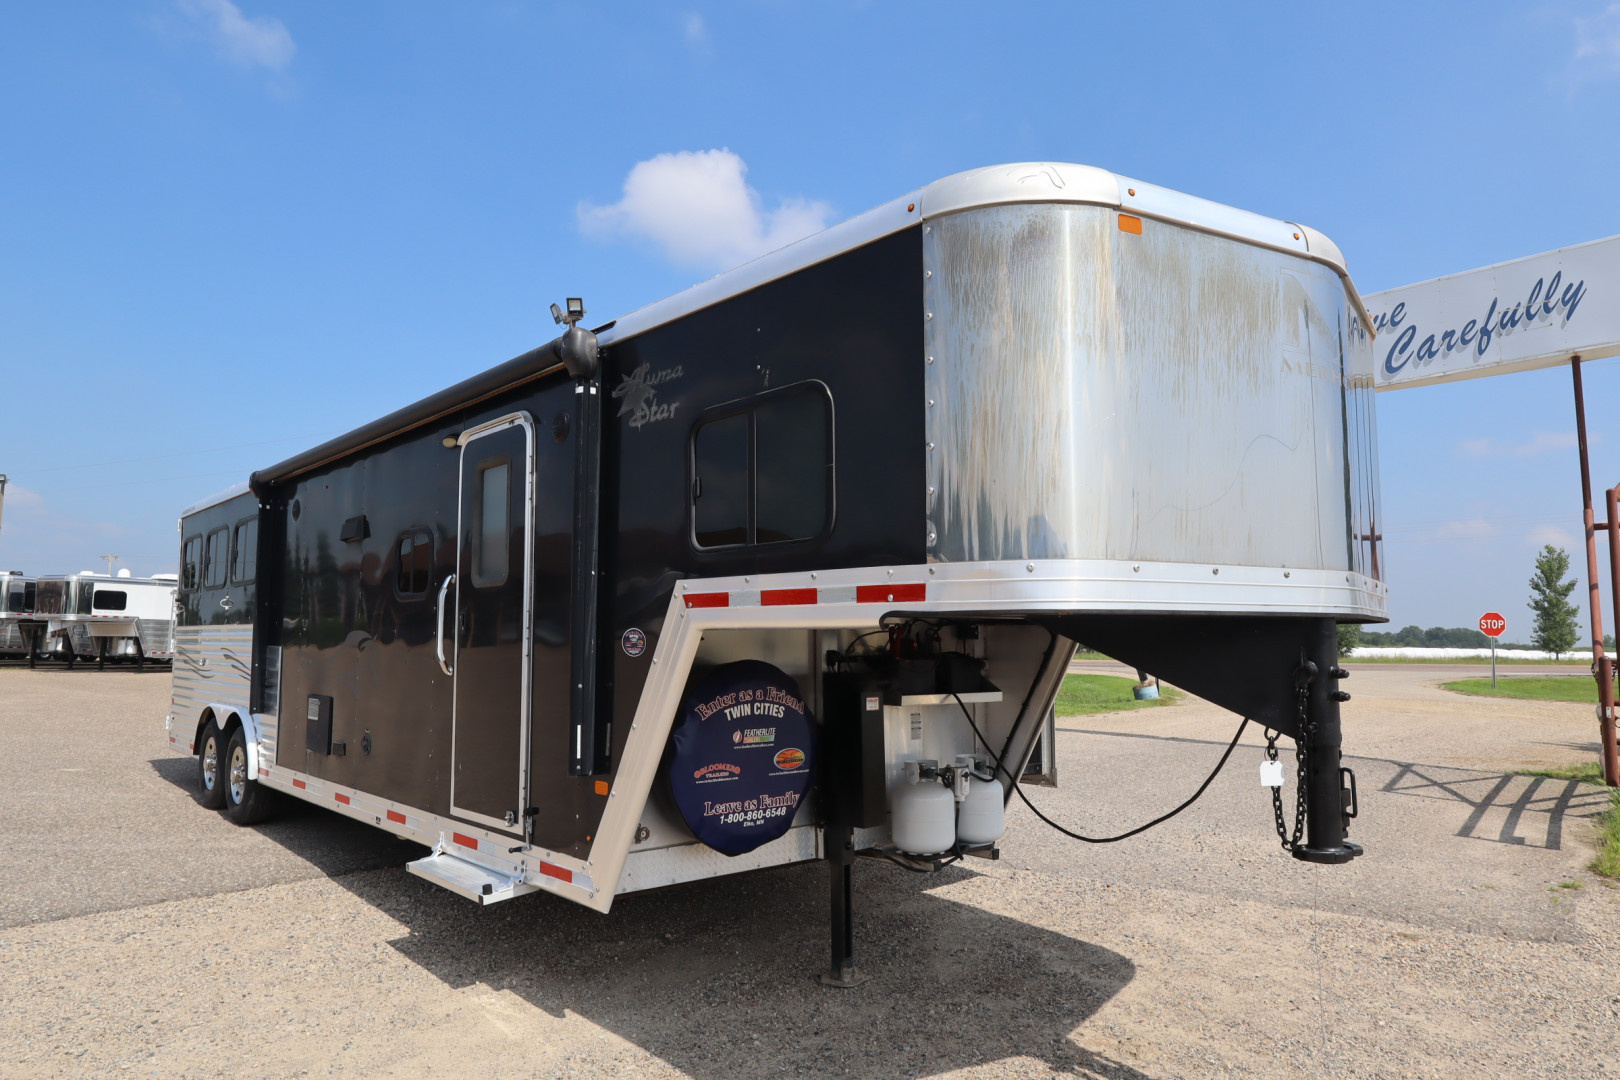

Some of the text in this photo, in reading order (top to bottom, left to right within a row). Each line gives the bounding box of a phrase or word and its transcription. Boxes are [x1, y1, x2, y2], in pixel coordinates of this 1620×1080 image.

[1384, 270, 1587, 375] Carefully
[629, 398, 681, 428] Star
[1481, 619, 1504, 629] STOP
[695, 686, 805, 721] Enter as a Friend
[724, 702, 786, 721] TWIN CITIES
[744, 728, 776, 737] FEATHERLITE
[703, 790, 800, 816] Leave as Family
[720, 806, 787, 825] 1-800-860-6548
